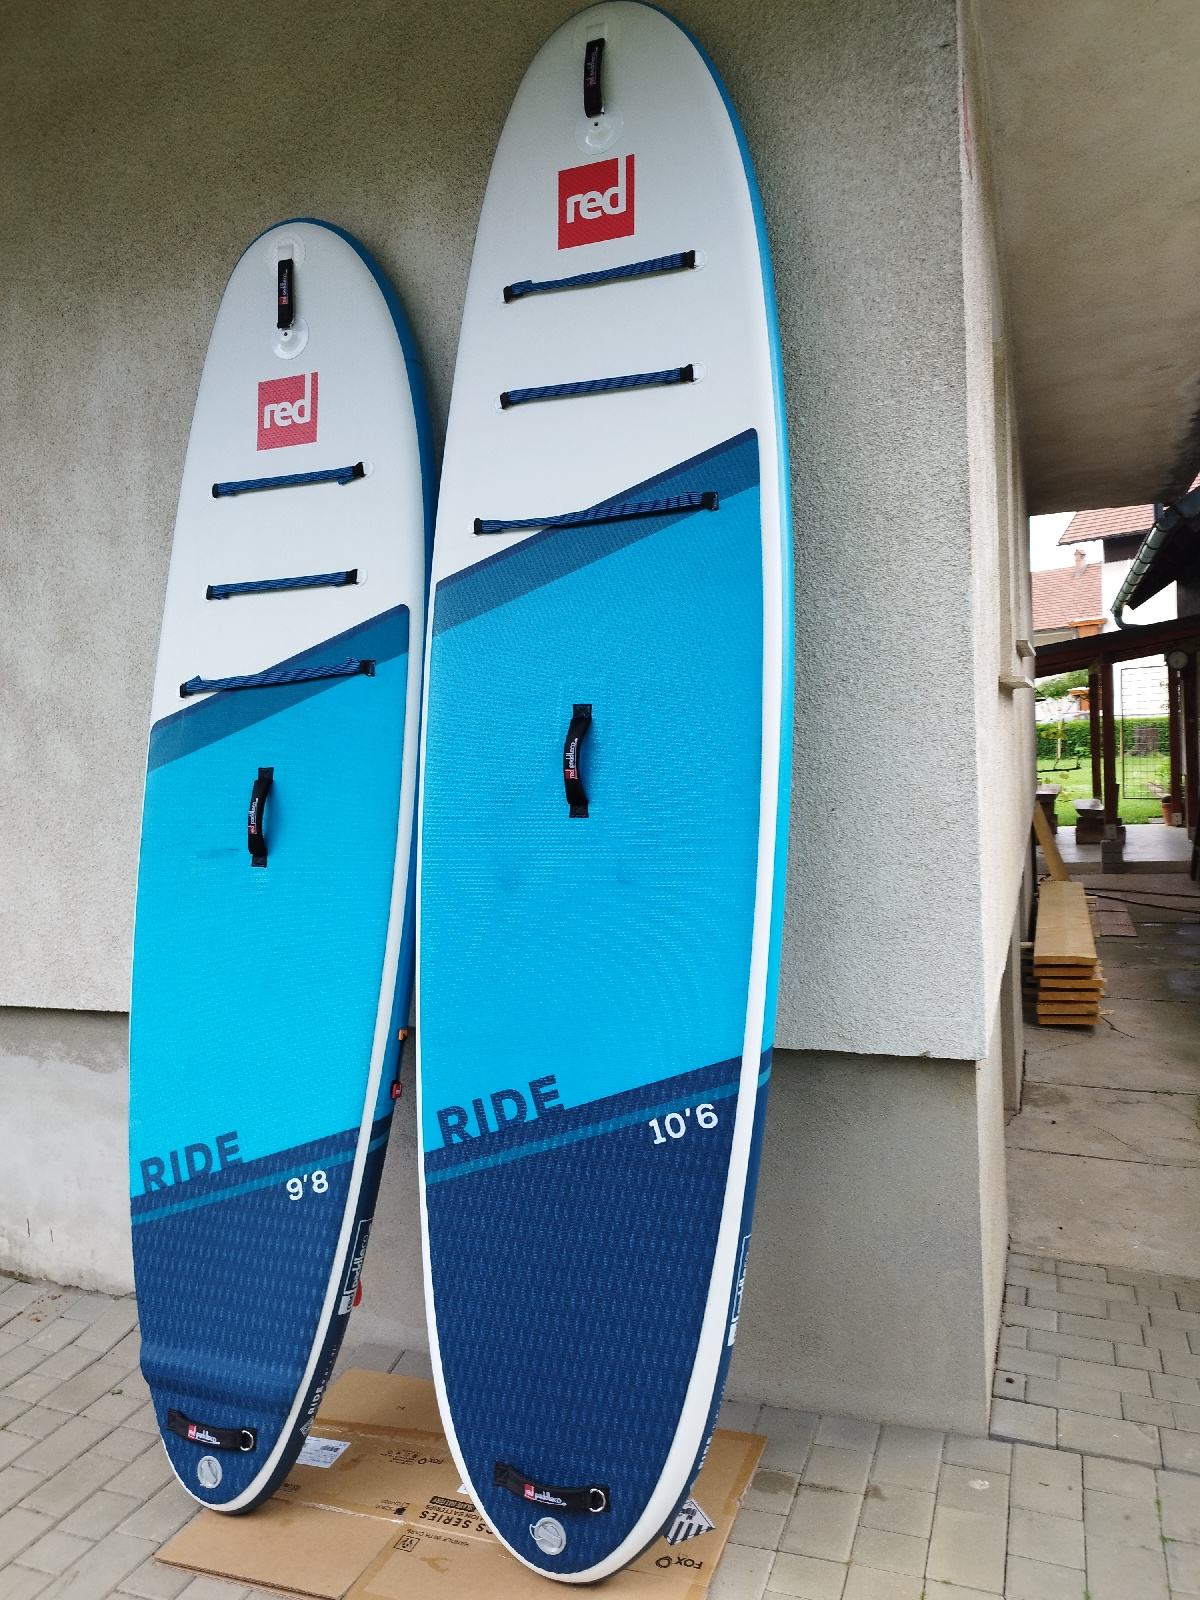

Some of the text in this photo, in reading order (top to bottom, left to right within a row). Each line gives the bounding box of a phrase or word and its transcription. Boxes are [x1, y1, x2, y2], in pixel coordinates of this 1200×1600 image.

[566, 156, 627, 224] red
[263, 374, 312, 429] red
[436, 1074, 566, 1148] RIDE
[648, 1103, 719, 1145] 10'6
[139, 1130, 243, 1195] RIDE
[286, 1170, 329, 1201] 9'8
[419, 1510, 472, 1529] SERIES
[675, 1556, 703, 1570] FOX
